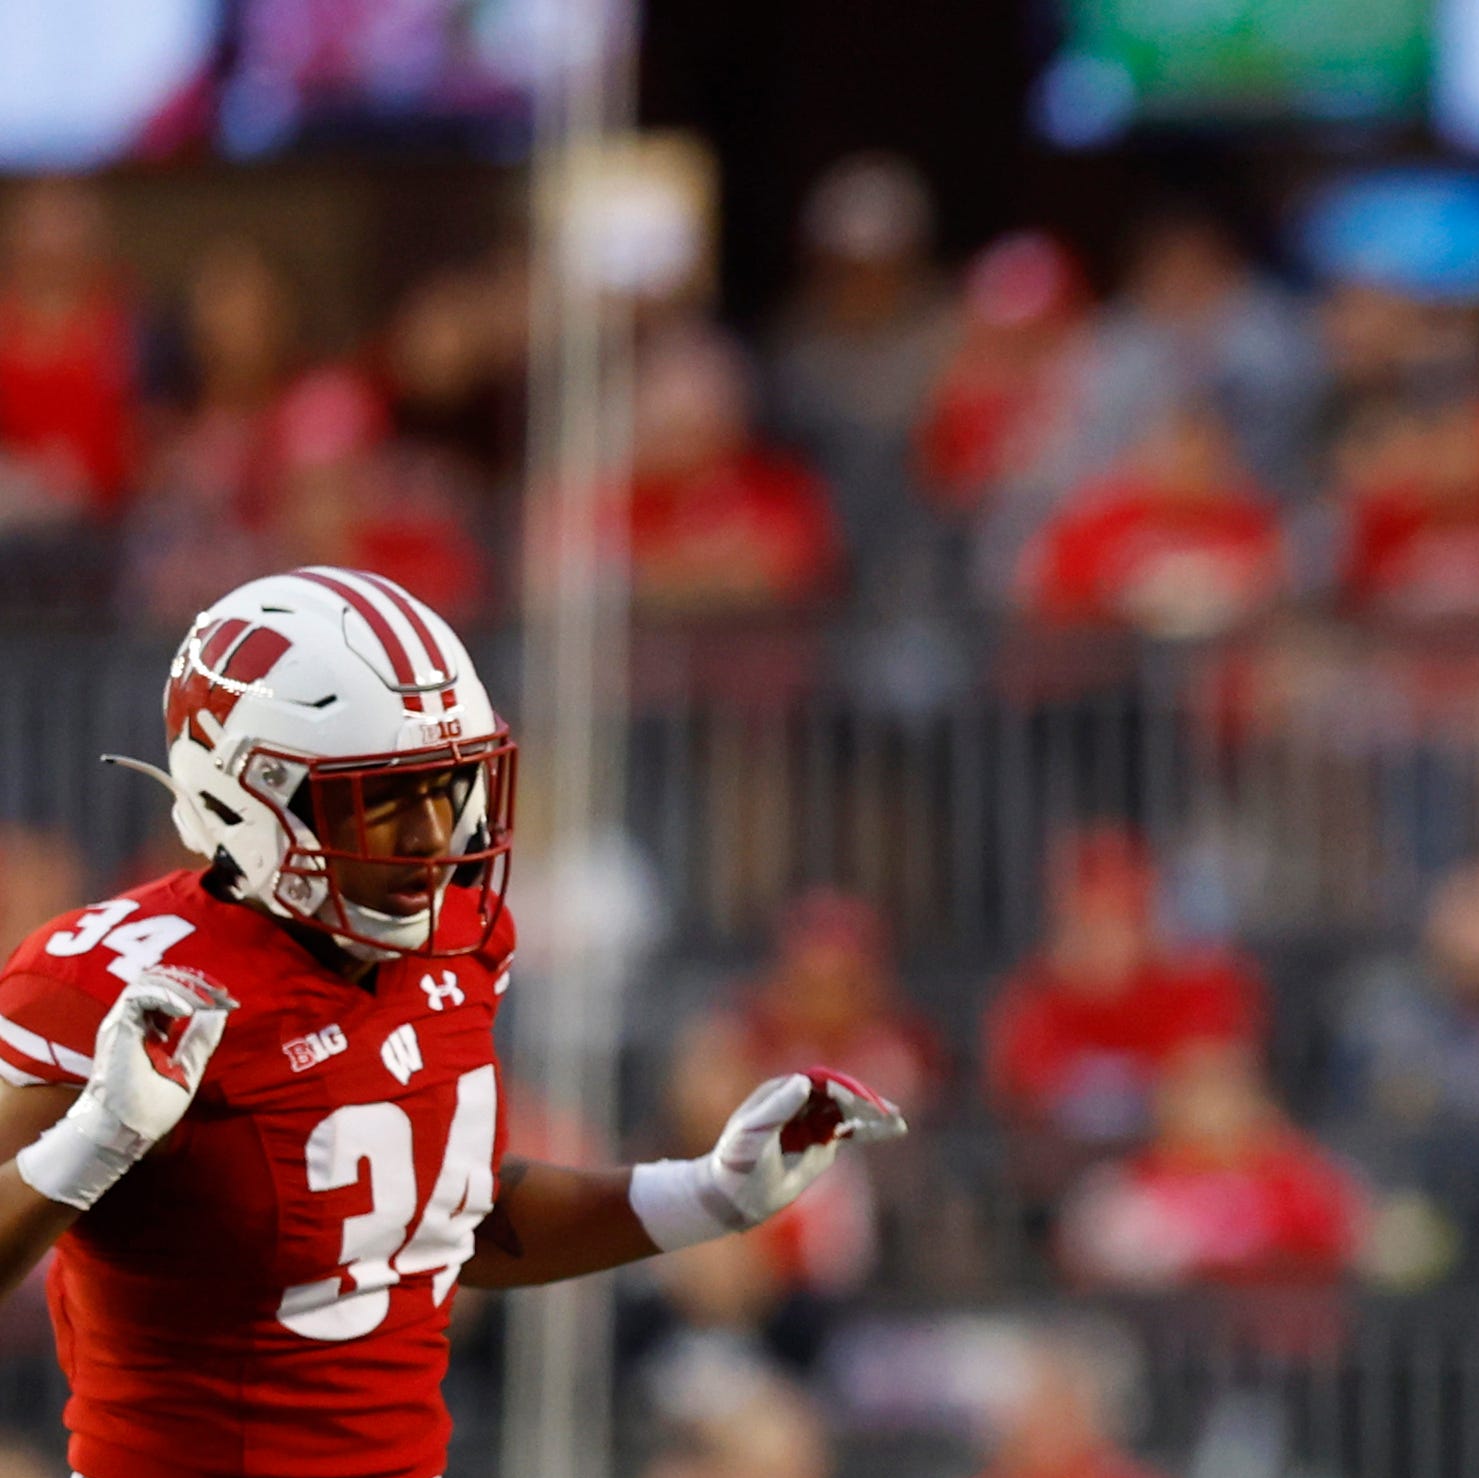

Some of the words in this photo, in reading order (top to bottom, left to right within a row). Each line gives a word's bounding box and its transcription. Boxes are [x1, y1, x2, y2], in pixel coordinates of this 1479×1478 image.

[45, 899, 197, 984] 34
[381, 1023, 424, 1085] W
[276, 1063, 498, 1341] 34
